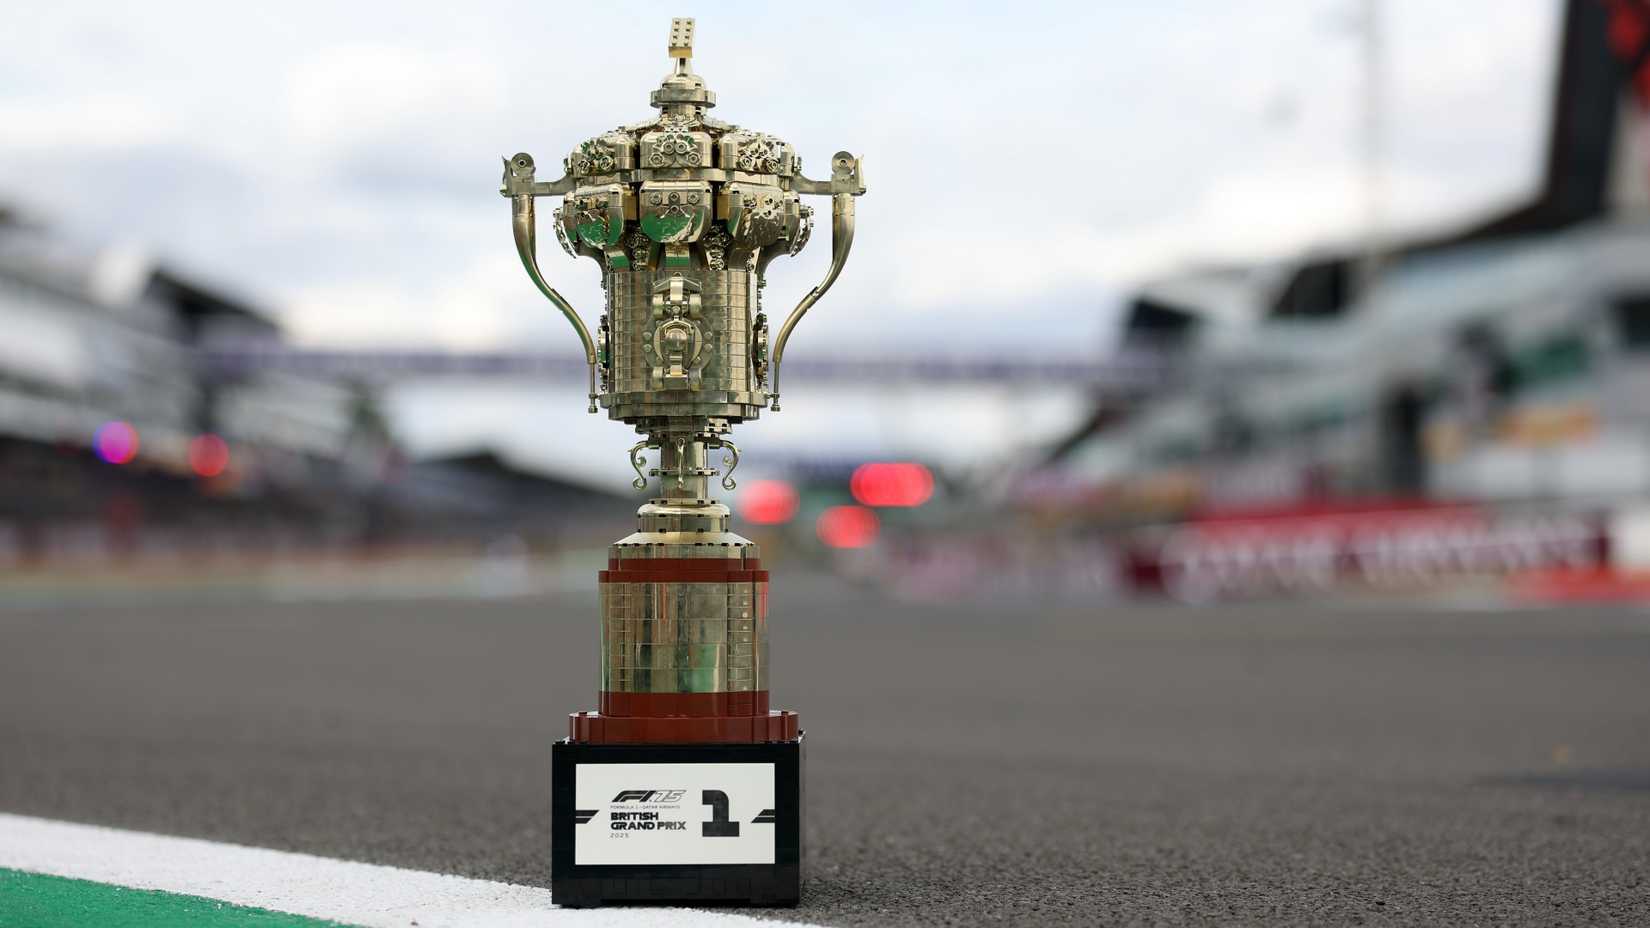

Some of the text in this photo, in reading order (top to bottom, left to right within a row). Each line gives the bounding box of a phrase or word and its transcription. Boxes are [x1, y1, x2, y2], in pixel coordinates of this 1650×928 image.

[611, 812, 658, 820] BRITISH
[702, 790, 739, 837] 1
[611, 821, 687, 830] GRAND PRIX
